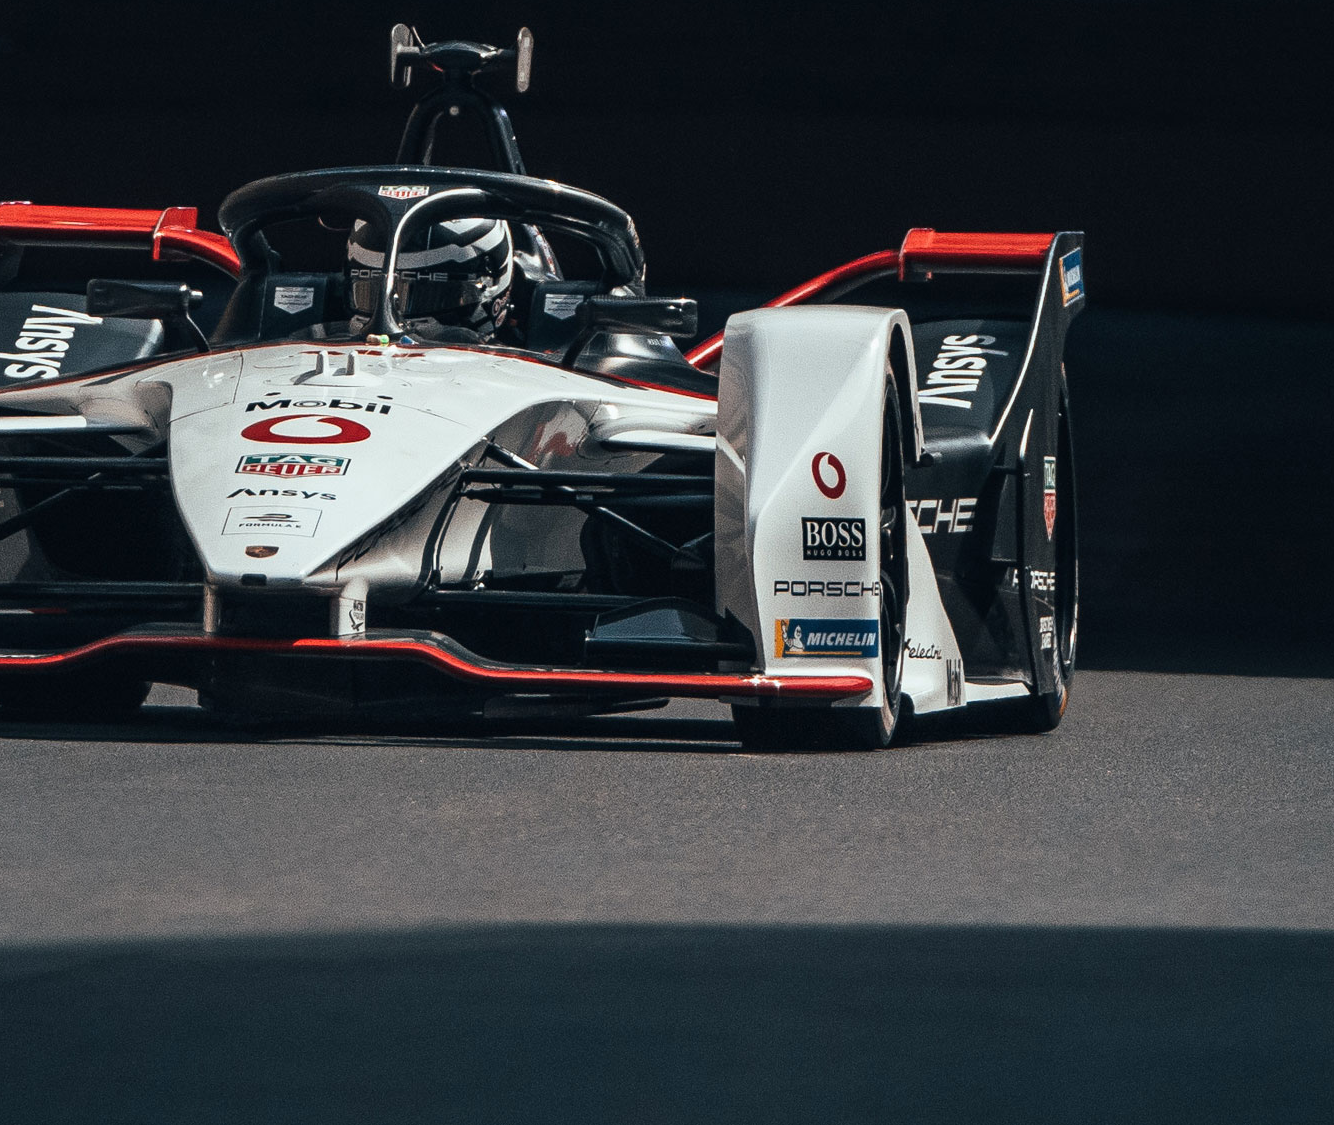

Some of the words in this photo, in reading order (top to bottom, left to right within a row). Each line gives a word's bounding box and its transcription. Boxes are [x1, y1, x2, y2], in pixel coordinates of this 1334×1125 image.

[917, 334, 1009, 409] Ansys
[245, 399, 392, 415] Mobil
[253, 455, 339, 466] TAG
[244, 463, 340, 475] HEUER
[226, 488, 337, 501] Ansys
[805, 521, 863, 547] BOSS
[807, 549, 832, 557] HUGO
[837, 549, 863, 557] BOSS
[773, 580, 881, 596] PORSCHE
[806, 632, 878, 646] MICHELIN
